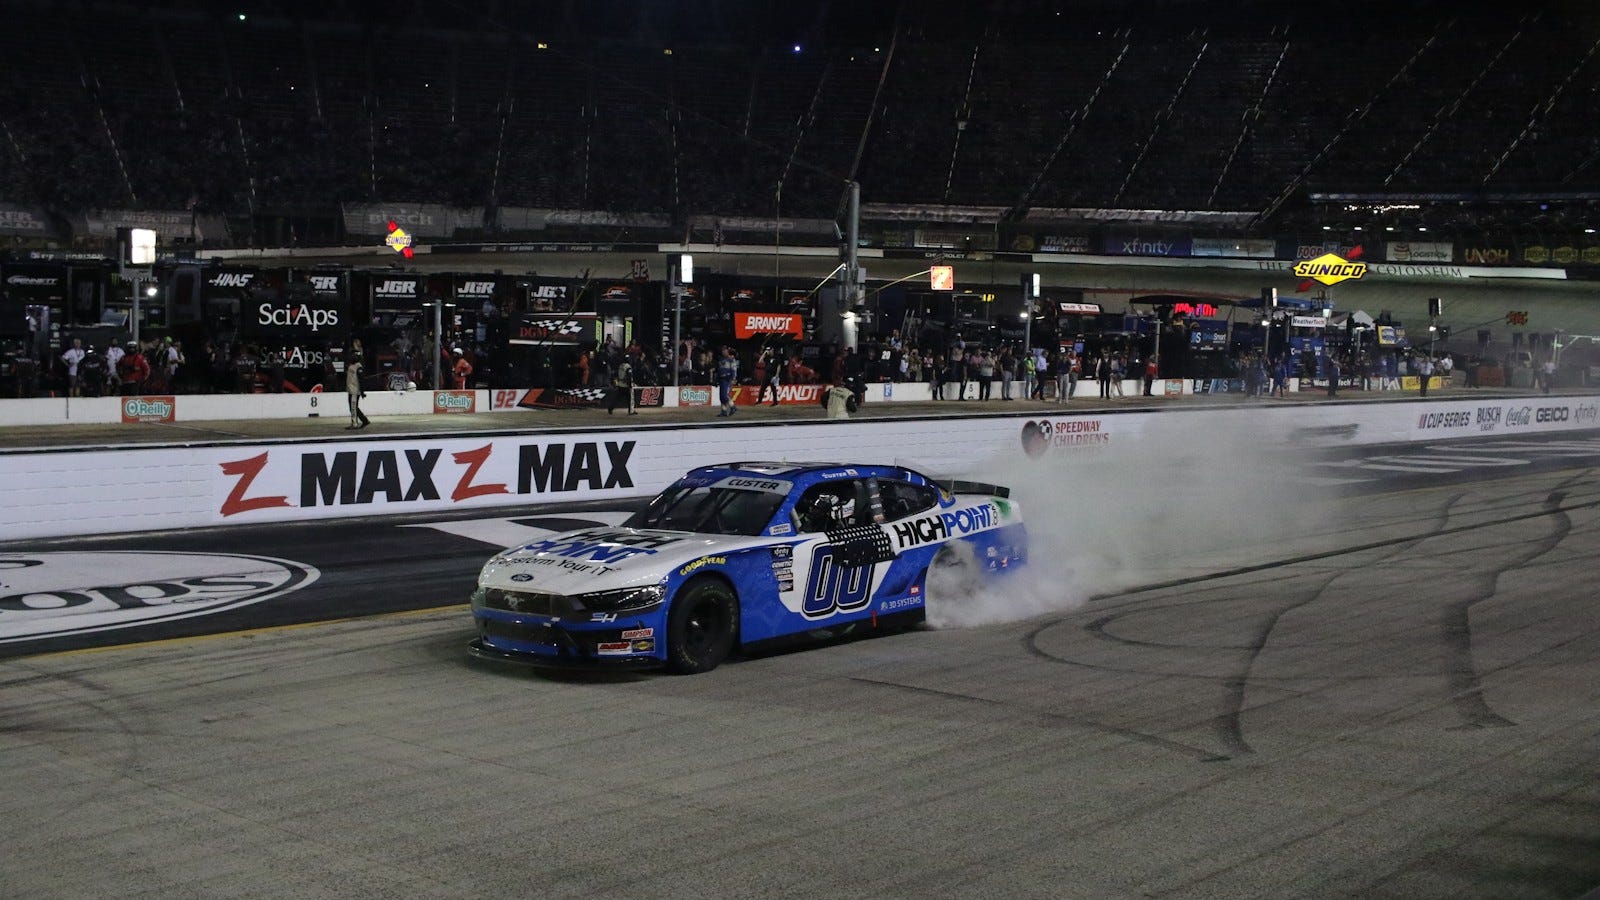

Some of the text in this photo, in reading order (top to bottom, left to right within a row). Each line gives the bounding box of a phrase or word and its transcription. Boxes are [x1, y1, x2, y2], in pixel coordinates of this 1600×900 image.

[386, 235, 411, 246] SUNOCO
[1122, 238, 1174, 255] xfinity
[1465, 248, 1509, 263] UNOH
[634, 261, 646, 279] 92
[1258, 262, 1285, 271] THE
[1297, 264, 1363, 276] SUNOCO
[1377, 265, 1462, 278] COLOSSEUM
[376, 280, 417, 294] JGR
[458, 281, 495, 294] JGR
[745, 316, 792, 331] BRANDT
[311, 397, 317, 407] 8
[437, 393, 472, 409] O'Reilly
[495, 391, 516, 408] 92
[640, 388, 660, 406] 92
[731, 388, 743, 402] 7
[126, 400, 171, 418] O'Reilly
[1476, 407, 1501, 424] BUSCH
[1536, 407, 1569, 423] GEICO
[1427, 411, 1471, 428] CUP SERIES
[1055, 421, 1102, 434] SPEEDWAY
[1053, 433, 1109, 448] CHILDREN'S
[517, 440, 637, 495] MAX
[301, 448, 442, 508] MAX
[729, 479, 779, 490] CUSTER
[557, 559, 592, 572] Your
[680, 556, 726, 576] GOODYEAR
[800, 542, 876, 621] 00
[897, 597, 921, 608] SYSTEMS
[624, 629, 651, 639] SIMPSON
